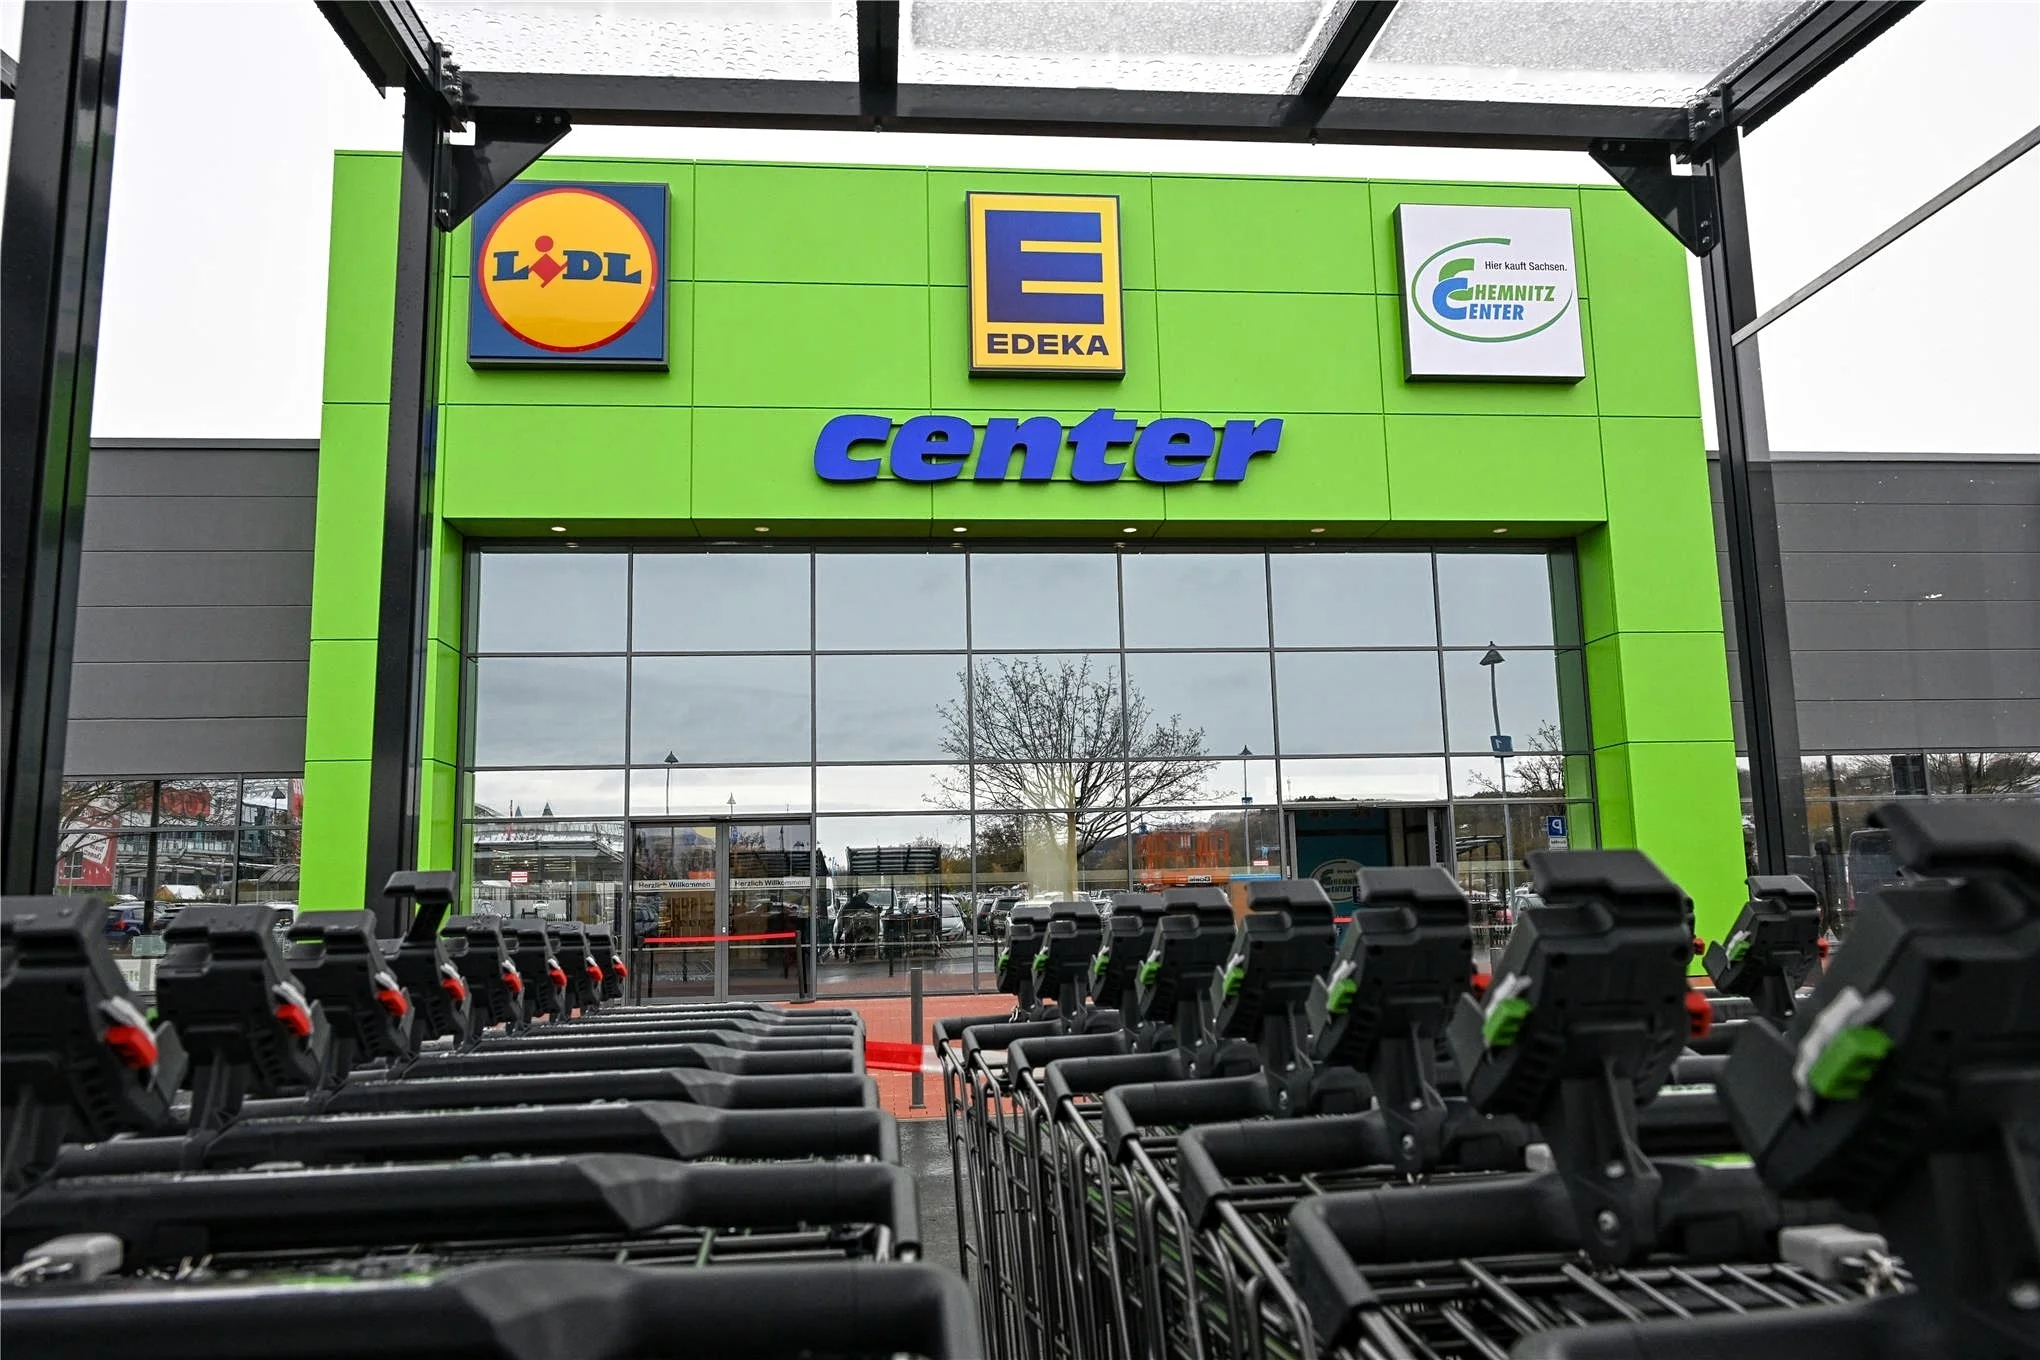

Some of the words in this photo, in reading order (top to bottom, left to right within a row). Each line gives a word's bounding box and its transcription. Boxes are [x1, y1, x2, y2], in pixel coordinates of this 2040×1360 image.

[1485, 260, 1502, 270] Hier
[1504, 260, 1527, 271] kauft
[1529, 261, 1568, 272] Sachsen.
[987, 333, 1110, 356] EDEKA
[813, 408, 1284, 483] center
[734, 879, 764, 887] Herzlich
